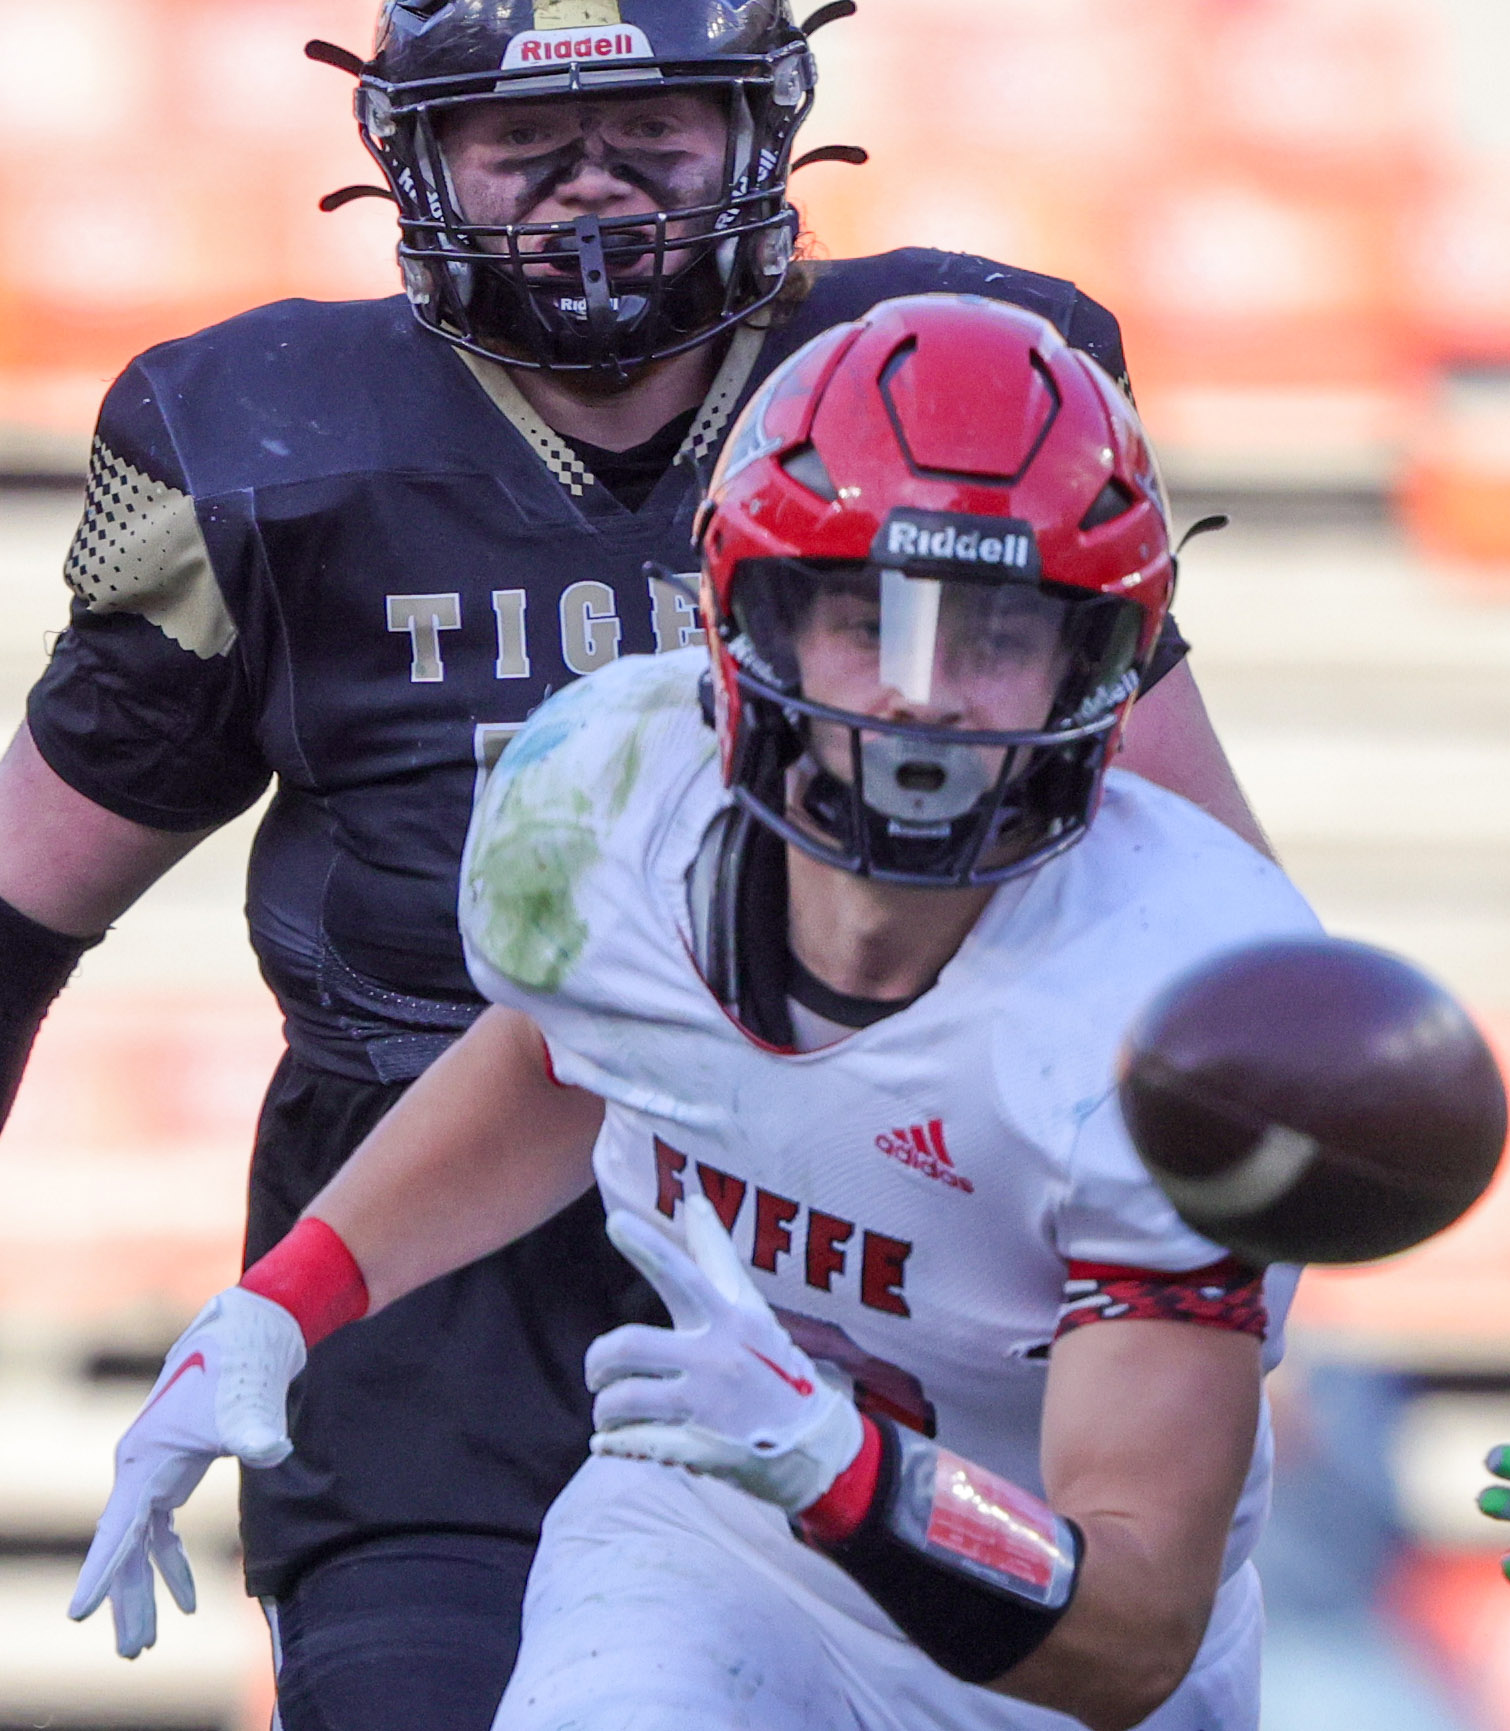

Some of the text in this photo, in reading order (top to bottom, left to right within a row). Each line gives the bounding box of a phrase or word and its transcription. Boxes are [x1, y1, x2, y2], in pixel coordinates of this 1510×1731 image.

[521, 34, 632, 61] Riddell
[888, 521, 1029, 568] Riddell
[386, 572, 705, 683] TIGE
[875, 1133, 975, 1194] adidas
[653, 1132, 913, 1318] FYFFE
